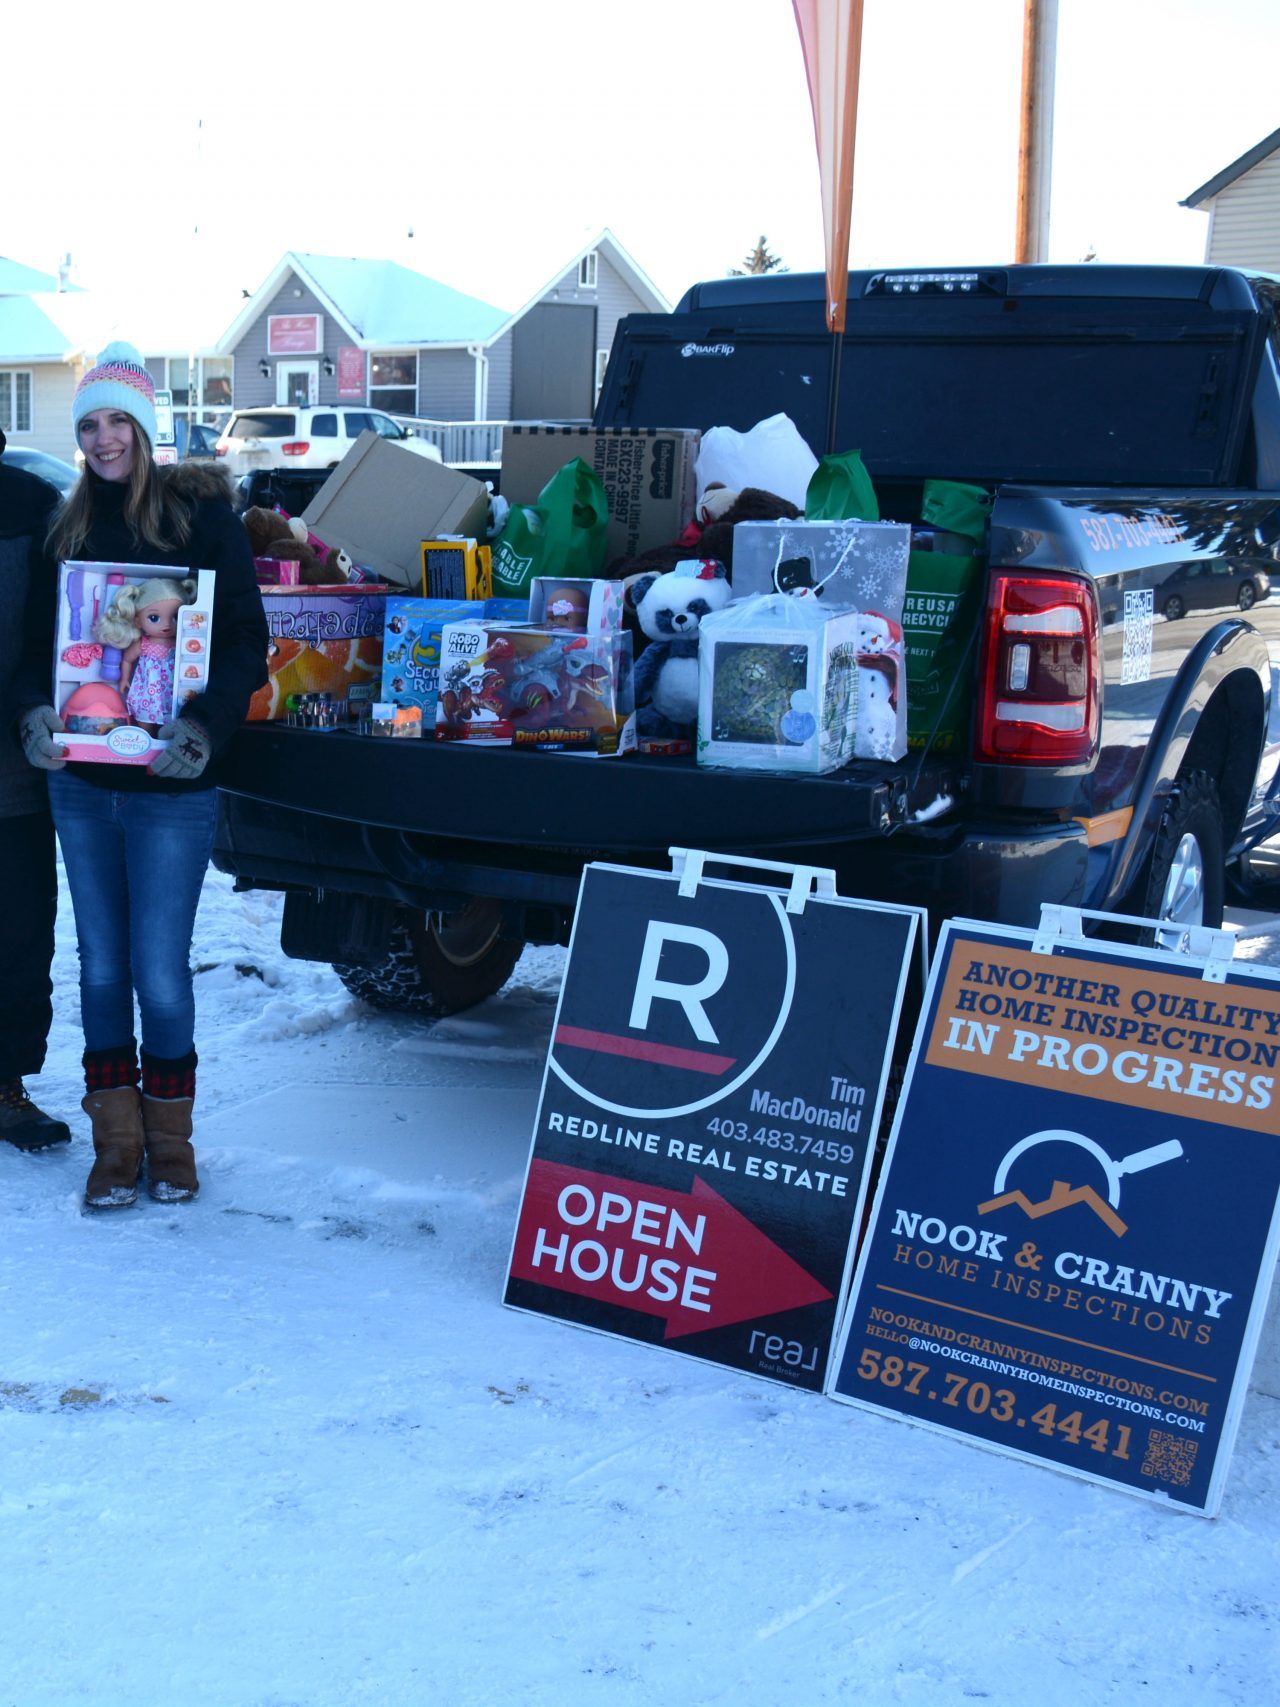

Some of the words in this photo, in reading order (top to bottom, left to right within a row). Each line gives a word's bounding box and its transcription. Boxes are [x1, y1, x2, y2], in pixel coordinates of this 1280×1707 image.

[605, 471, 616, 481] IN
[606, 439, 618, 468] MADE
[630, 439, 646, 501] Fisher-Price
[657, 442, 671, 497] fisher-price
[605, 484, 616, 515] CHINA
[615, 439, 632, 525] GXC23-9997
[629, 503, 641, 531] Little
[626, 533, 639, 558] Peop
[906, 597, 956, 612] REUSA
[448, 632, 480, 646] ROBO
[448, 643, 478, 654] ALIVE
[405, 660, 440, 679] SECO
[413, 678, 440, 694] RUL
[629, 920, 730, 1044] R
[963, 960, 1121, 1008] ANOTHER
[1131, 989, 1280, 1037] QUALITY
[955, 988, 1055, 1026] HOME
[1061, 1007, 1279, 1069] INSPECTION
[942, 1016, 995, 1056] IN
[1007, 1028, 1275, 1111] PROGRESS
[750, 1089, 862, 1134] MacDonald
[831, 1076, 865, 1106] Tim
[548, 1113, 661, 1154] REDLINE
[667, 1139, 737, 1172] REAL
[744, 1158, 849, 1197] ESTATE
[706, 1117, 855, 1165] 403.483.7459
[557, 1183, 707, 1256] OPEN
[531, 1227, 717, 1313] HOUSE
[891, 1209, 1009, 1263] NOOK
[1013, 1241, 1044, 1273] &
[1053, 1251, 1232, 1319] CRANNY
[893, 1244, 980, 1283] HOME
[993, 1268, 1213, 1345] INSPECTIONS
[748, 1330, 819, 1371] real
[758, 1360, 776, 1371] Real
[776, 1365, 801, 1378] Broker
[869, 1306, 1209, 1417] NOOKANDCRANNYINSPECTIONS.COM
[865, 1324, 1206, 1434] HELLO@NOOKCRANNYHOMEINSPECTIONS.COM
[856, 1348, 1131, 1462] 587.703.4441
